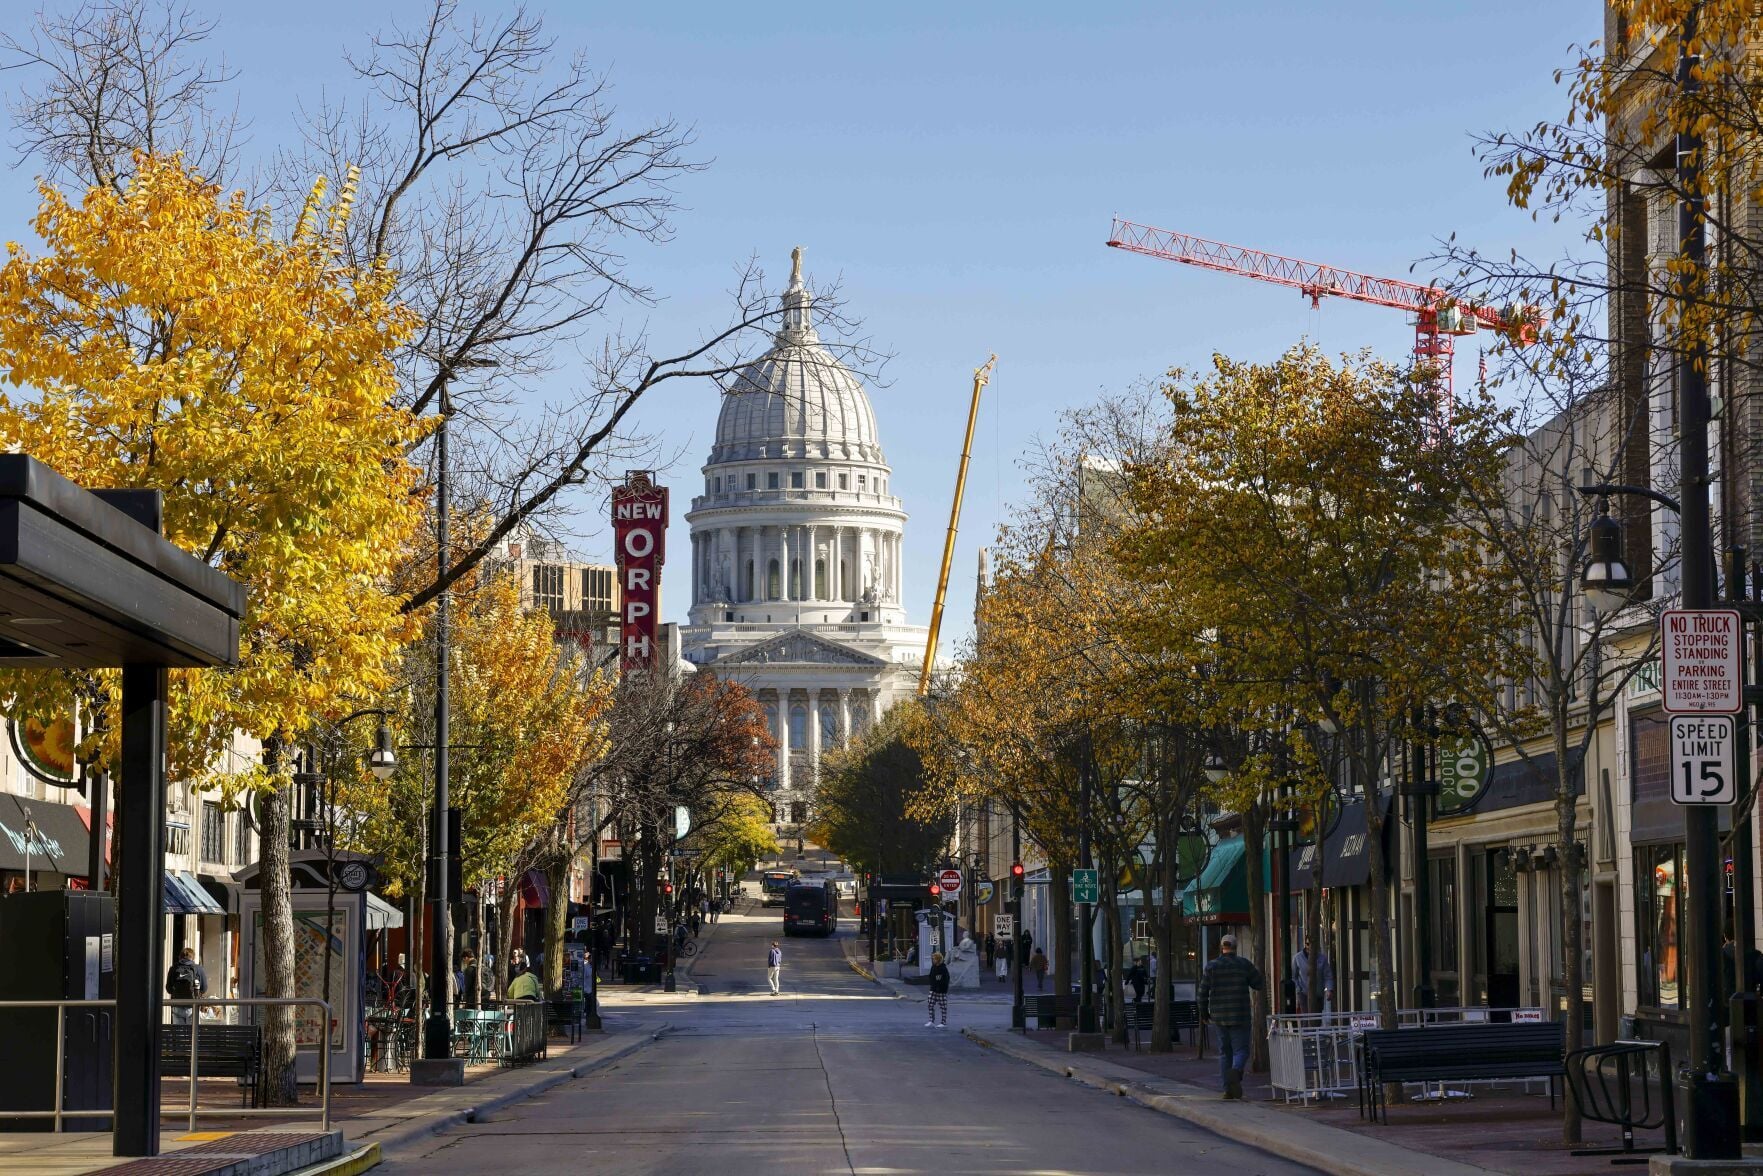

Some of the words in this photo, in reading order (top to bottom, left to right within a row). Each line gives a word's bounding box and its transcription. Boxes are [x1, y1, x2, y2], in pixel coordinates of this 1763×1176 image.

[617, 503, 662, 520] NEW
[1670, 617, 1686, 633] NO
[1692, 616, 1730, 633] TRUCK
[1674, 635, 1728, 646] STOPPING
[1675, 648, 1728, 660] STANDING
[1679, 665, 1725, 677] PARKING
[1672, 680, 1699, 691] ENTIRE
[1703, 680, 1731, 691] STREET
[1677, 724, 1728, 739] SPEED
[1682, 741, 1722, 756] LIMIT
[1441, 749, 1455, 795] BLOCK
[1456, 738, 1480, 798] 300
[1682, 761, 1725, 797] 15
